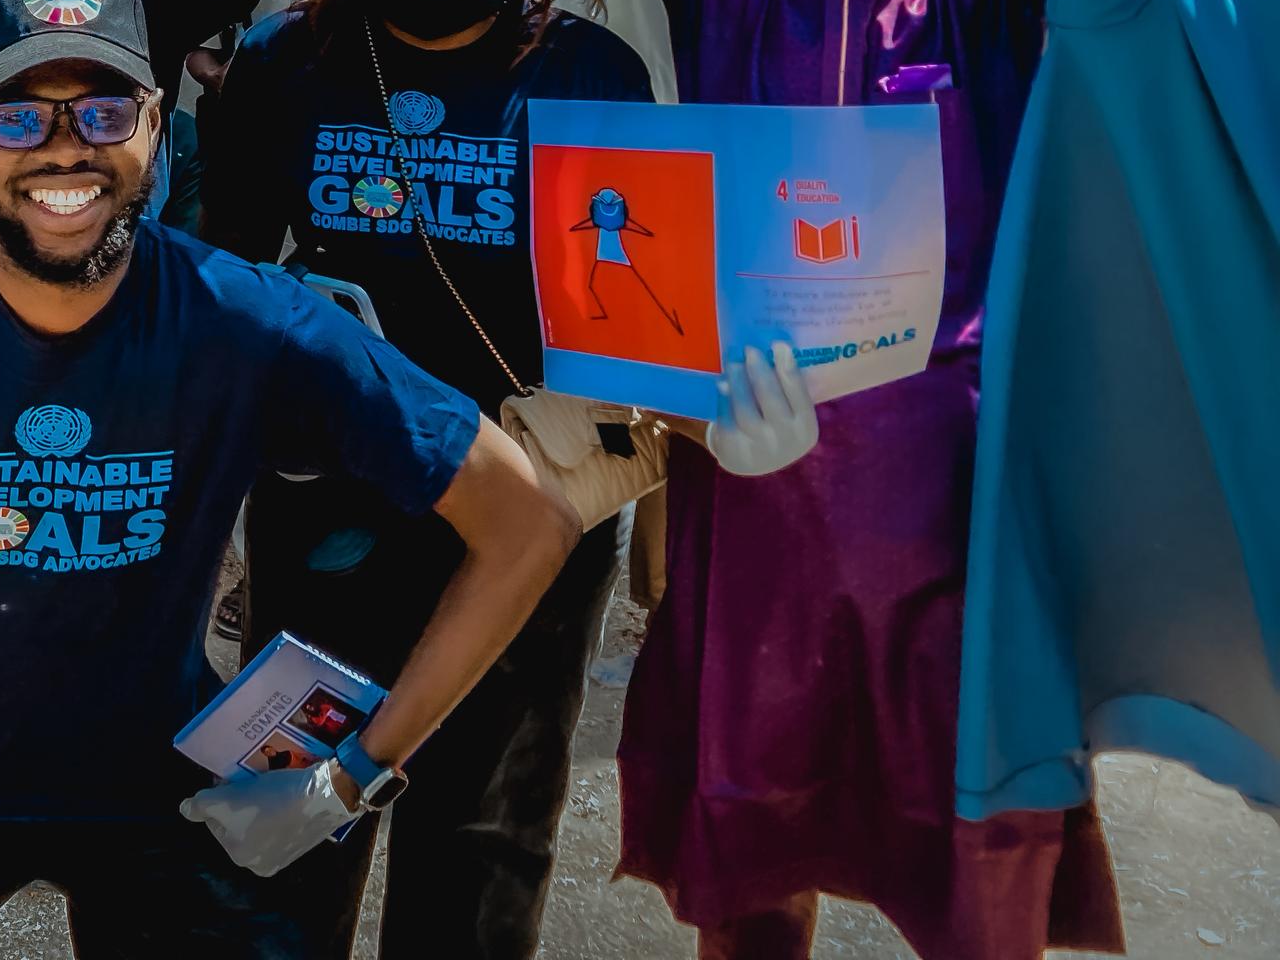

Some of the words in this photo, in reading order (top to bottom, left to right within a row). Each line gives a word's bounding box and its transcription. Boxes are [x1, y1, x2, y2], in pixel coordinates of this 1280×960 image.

[315, 132, 517, 166] SUSTAINABLE
[313, 154, 515, 186] DEVELOPMENT
[308, 175, 515, 230] GOALS
[777, 180, 789, 202] 4
[311, 212, 370, 233] GOMBE
[376, 217, 412, 234] SDG
[426, 223, 516, 246] DVOCATES
[43, 543, 162, 572] ADVOCATES
[237, 706, 267, 733] THANKS
[244, 694, 292, 740] COMING
